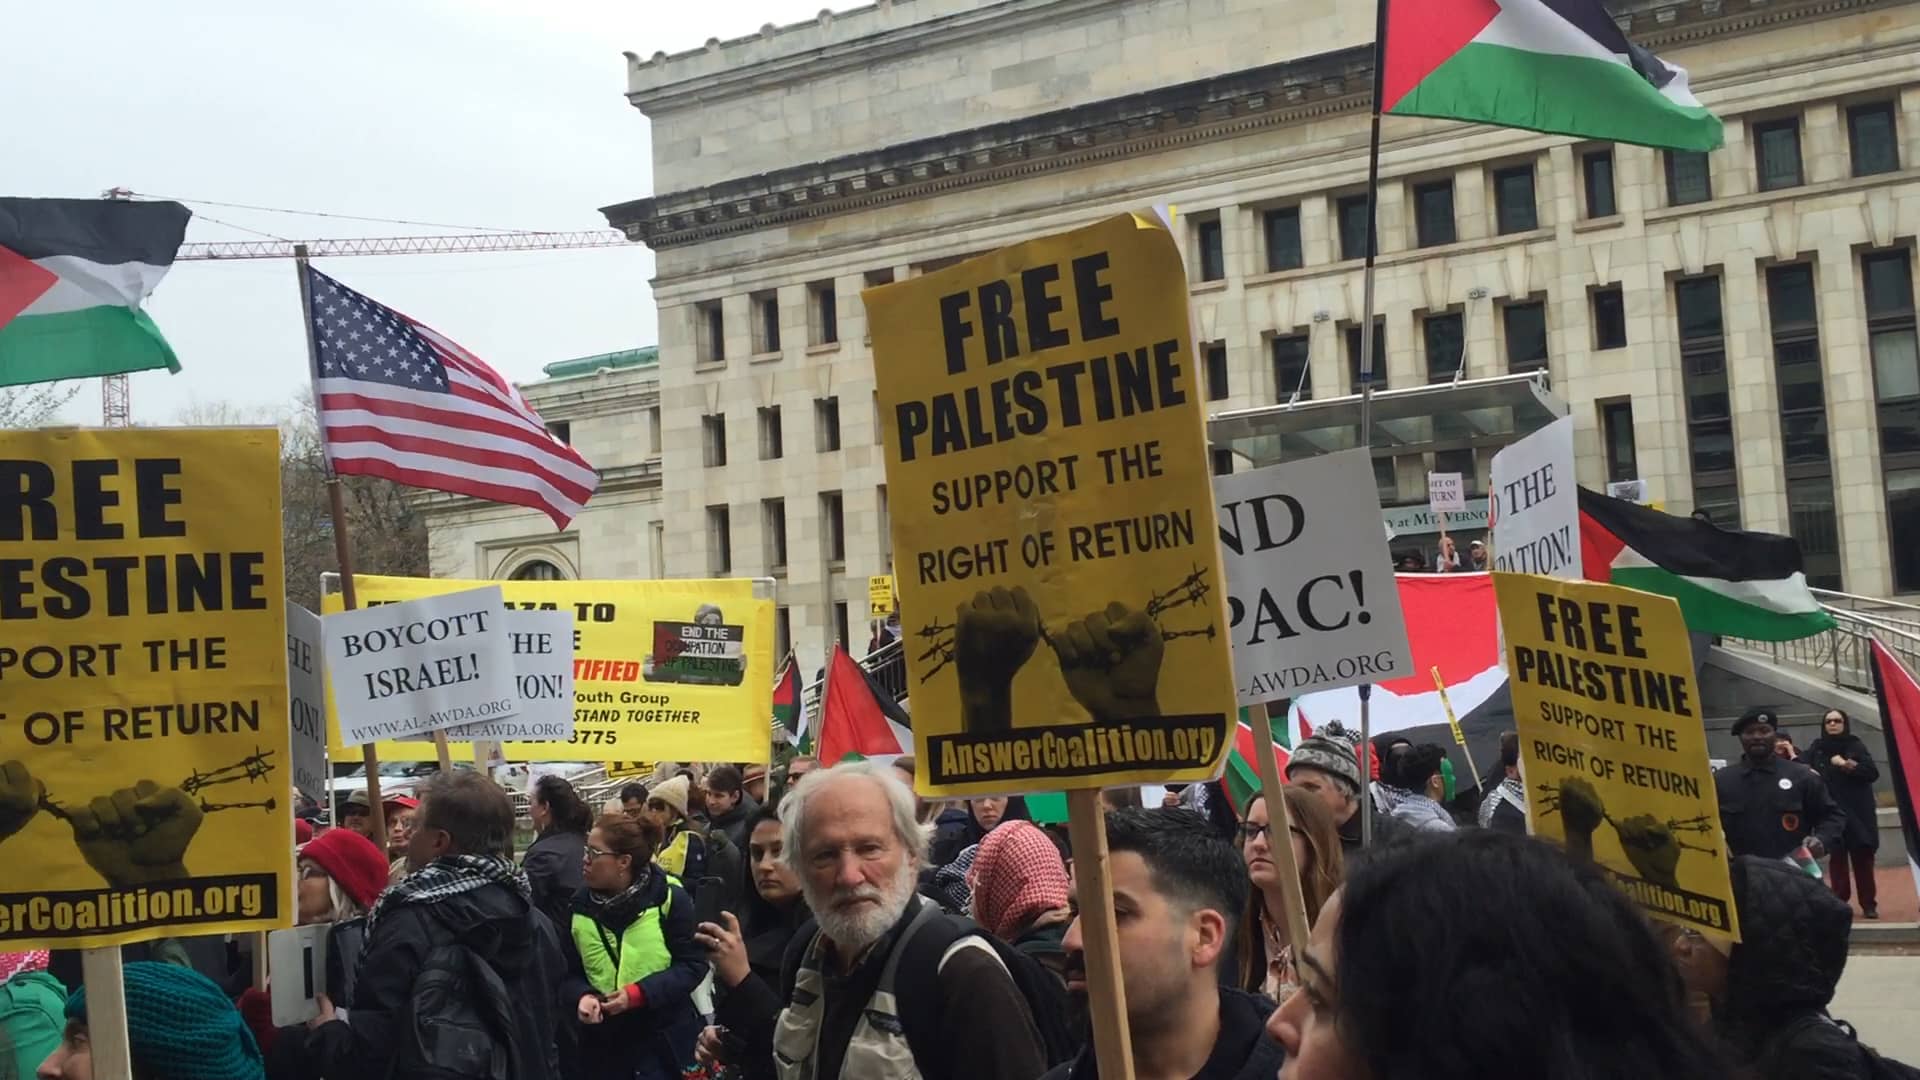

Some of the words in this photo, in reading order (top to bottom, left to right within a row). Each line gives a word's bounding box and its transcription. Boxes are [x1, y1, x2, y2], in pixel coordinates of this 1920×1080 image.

[939, 251, 1120, 376] FREE
[896, 339, 1186, 463] PALESTINE
[0, 459, 186, 540] REE
[932, 455, 1079, 515] SUPPORT
[1097, 440, 1163, 484] THE
[1503, 463, 1557, 516] THE
[918, 538, 1009, 586] RIGHT
[1022, 531, 1056, 569] OF
[1069, 508, 1195, 562] RETURN
[1218, 493, 1306, 557] ND
[0, 552, 268, 620] ESTINE
[573, 602, 617, 623] TO
[341, 610, 489, 658] BOYCOTT
[508, 632, 553, 654] HE
[681, 626, 703, 638] END
[705, 627, 728, 640] THE
[1536, 592, 1648, 660] FREE
[0, 643, 122, 680] PORT
[142, 637, 227, 673] THE
[364, 652, 480, 700] ISRAEL!
[1514, 646, 1692, 718] PALESTINE
[24, 711, 84, 745] OF
[103, 700, 259, 741] RETURN
[351, 699, 512, 741] WWW.AL-AWDA.ORG
[573, 710, 621, 724] STAND
[627, 710, 700, 724] TOGETHER
[620, 691, 669, 706] Group
[941, 724, 1216, 777] AnswerCoalition.org
[1540, 701, 1625, 742] SUPPORT
[1635, 723, 1678, 753] THE
[1533, 740, 1585, 773] RIGHT
[1590, 758, 1615, 781] OF
[1622, 763, 1700, 800] RETURN
